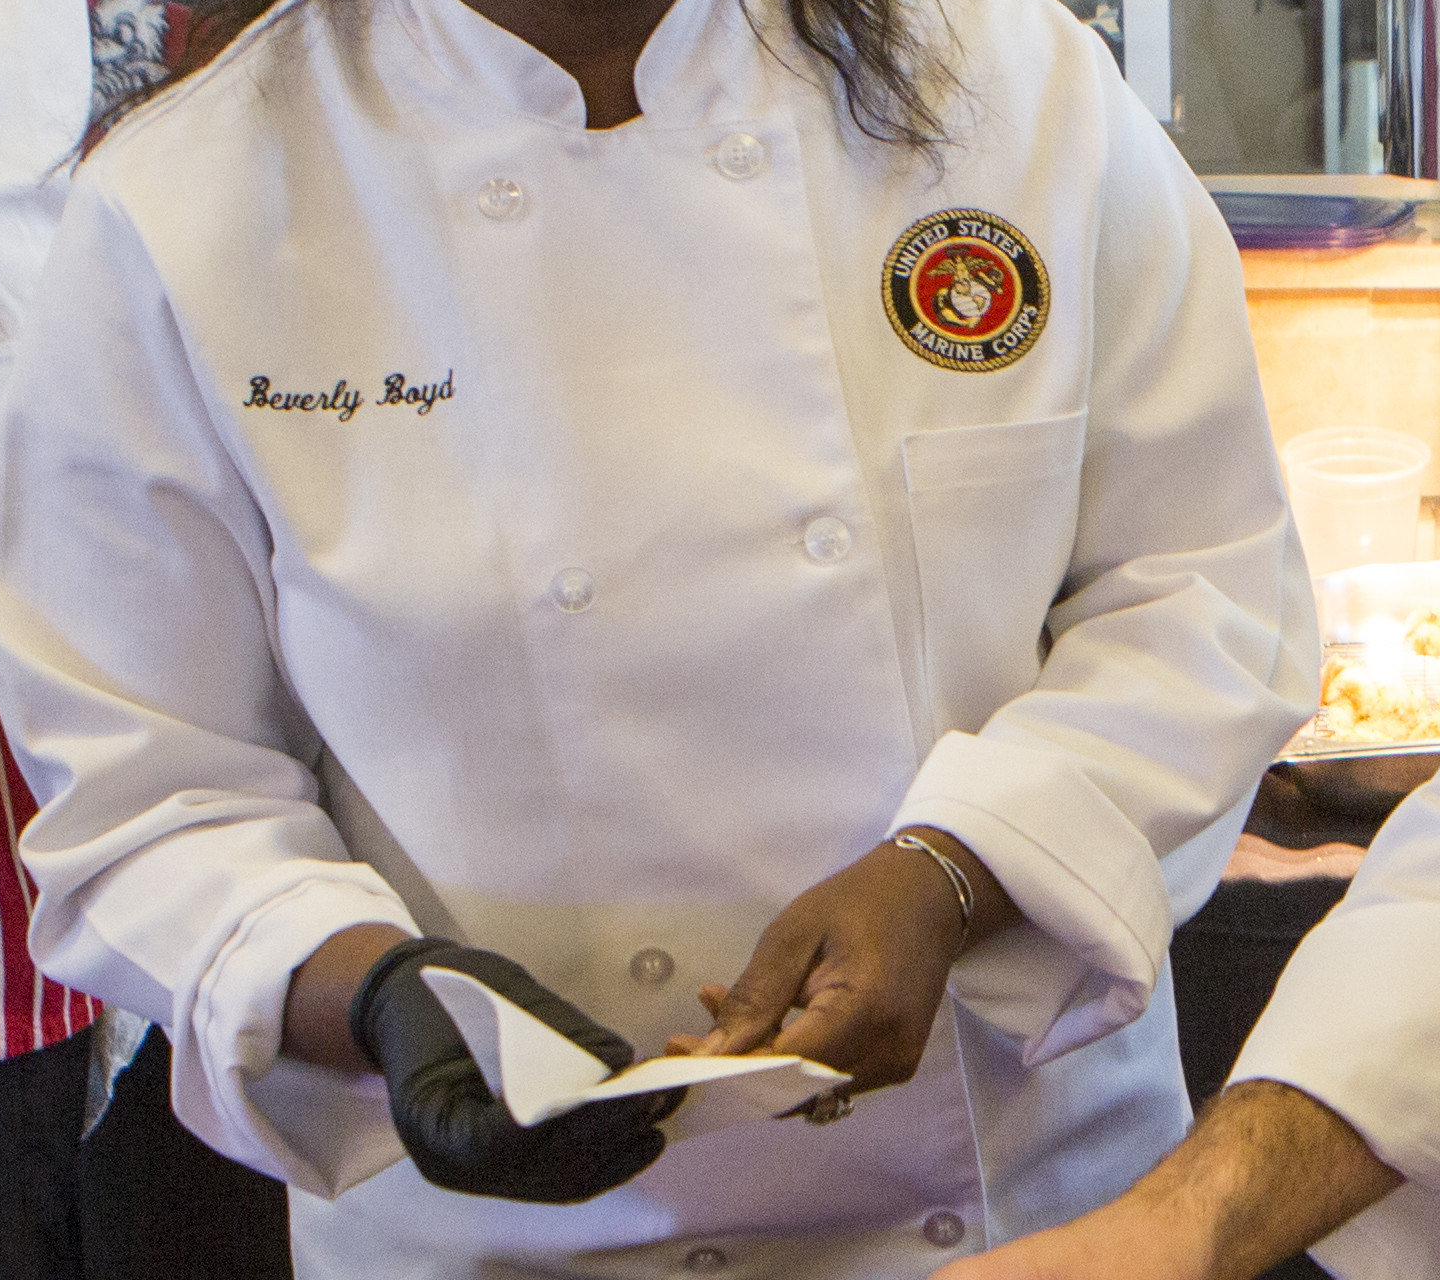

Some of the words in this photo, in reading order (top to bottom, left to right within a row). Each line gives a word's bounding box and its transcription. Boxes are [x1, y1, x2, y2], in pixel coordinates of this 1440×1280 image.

[895, 223, 949, 278] UNITED
[958, 220, 1024, 260] STATES
[911, 322, 985, 361] MARINE
[992, 304, 1038, 354] CORPS
[243, 375, 364, 422] Beverly
[376, 368, 455, 416] Boyd
